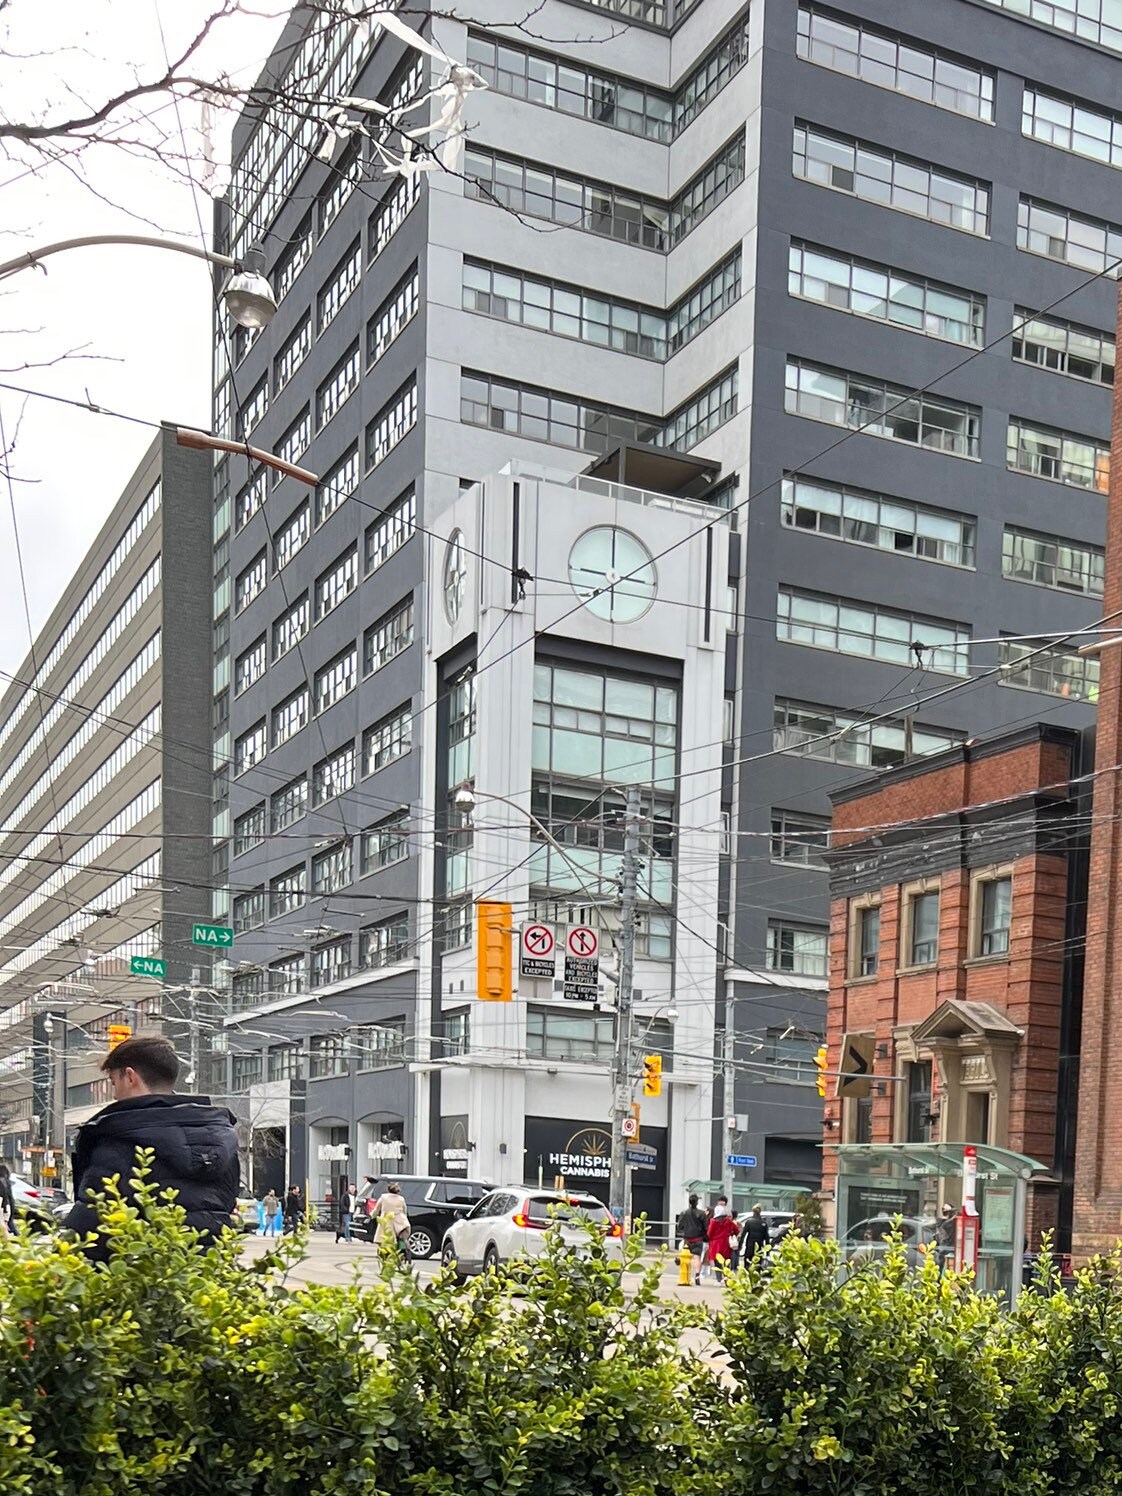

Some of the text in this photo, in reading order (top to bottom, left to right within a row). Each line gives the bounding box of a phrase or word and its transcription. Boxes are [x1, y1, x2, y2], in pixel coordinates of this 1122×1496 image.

[195, 928, 218, 942] NA
[143, 960, 164, 975] NA
[524, 967, 552, 976] EXCEPTED
[569, 963, 594, 971] VEHICLES
[568, 976, 594, 984] EXCEPTED
[549, 1153, 611, 1168] HEMISPH
[560, 1166, 610, 1178] CANNABIS
[989, 1172, 998, 1180] St
